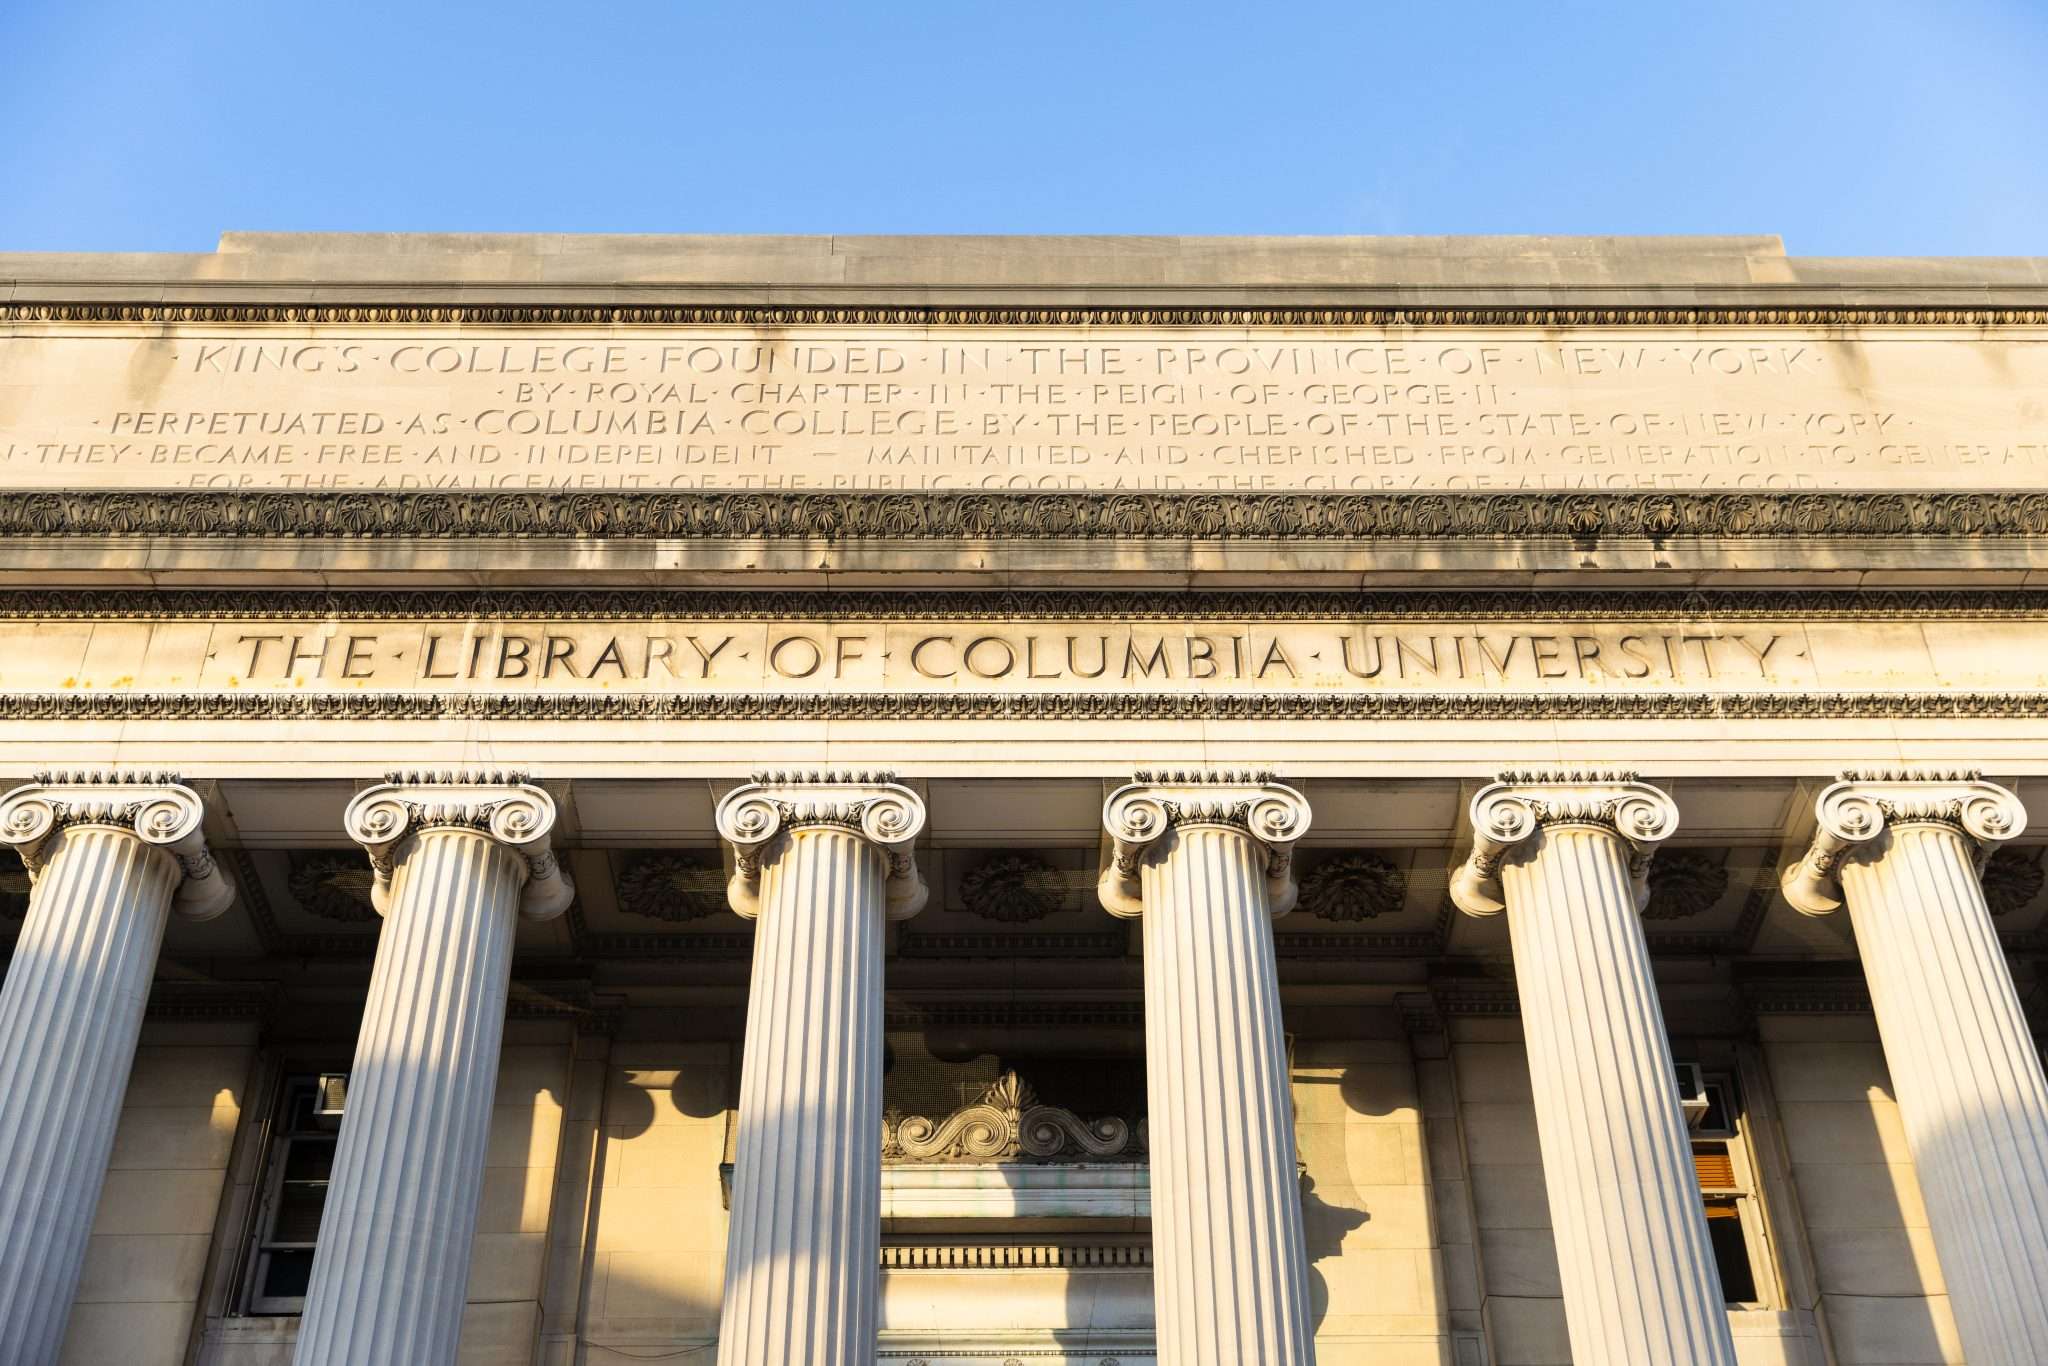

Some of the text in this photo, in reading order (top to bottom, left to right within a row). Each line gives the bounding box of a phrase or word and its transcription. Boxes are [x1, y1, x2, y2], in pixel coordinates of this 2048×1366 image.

[389, 346, 628, 373] COLLEGE
[660, 346, 905, 374] FOUNDED
[941, 347, 989, 374] IN
[1020, 348, 1126, 374] THE
[1156, 348, 1412, 374] PROVINCE
[1438, 348, 1500, 374] OF
[1534, 348, 1646, 374] NEW
[1674, 348, 1815, 374] YORK
[515, 383, 1498, 405] BY ROYAL CHARTER IN THE REIGN OF GEORGE II
[110, 410, 1895, 436] PERPETUATED AS COLUMBIA COLLEGE BY THE PEOPLE OF THE STATE OF NEW YORK
[36, 444, 132, 464] THEY
[149, 444, 294, 464] BECAME
[317, 444, 403, 464] FREE
[424, 445, 502, 464] AND
[526, 445, 784, 464] INDEPENDENT
[867, 445, 1092, 465] MAINTAINED
[1115, 445, 1189, 465] AND
[1213, 445, 1415, 465] CHERISHED
[1440, 446, 1537, 465] FROM
[1560, 445, 1788, 465] GENERATION
[1808, 445, 1856, 464] TO
[189, 474, 254, 488] FOR
[279, 474, 348, 488] THE
[375, 474, 653, 489] ADVANCEMENT
[670, 474, 721, 489] OF
[738, 475, 807, 489] THE
[832, 475, 953, 489] PUBLIC
[981, 475, 1087, 489] GOOD
[1114, 475, 1186, 489] AND
[1208, 475, 1279, 489] THE
[1303, 475, 1421, 489] GLORY
[1446, 475, 1491, 489] OF
[1737, 474, 1819, 489] GOD
[237, 635, 1782, 679] THE LIBRARY OF COLUMBIA UNIVERSITY
